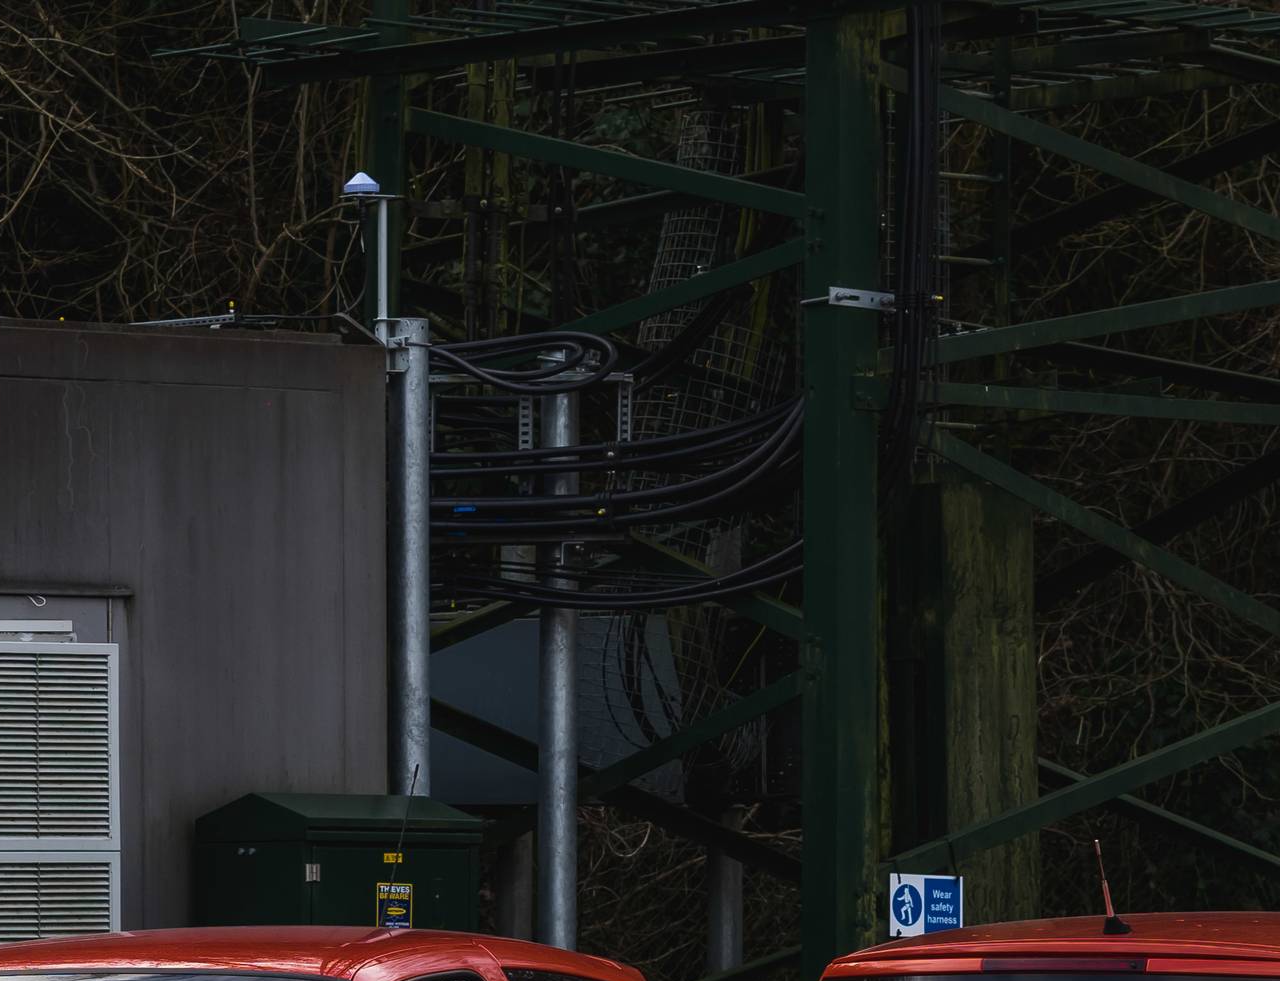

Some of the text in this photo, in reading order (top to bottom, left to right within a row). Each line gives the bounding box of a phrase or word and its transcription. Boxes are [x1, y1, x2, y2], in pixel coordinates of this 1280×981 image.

[933, 889, 952, 898] Wear
[930, 902, 954, 914] safety
[928, 915, 957, 924] harness
